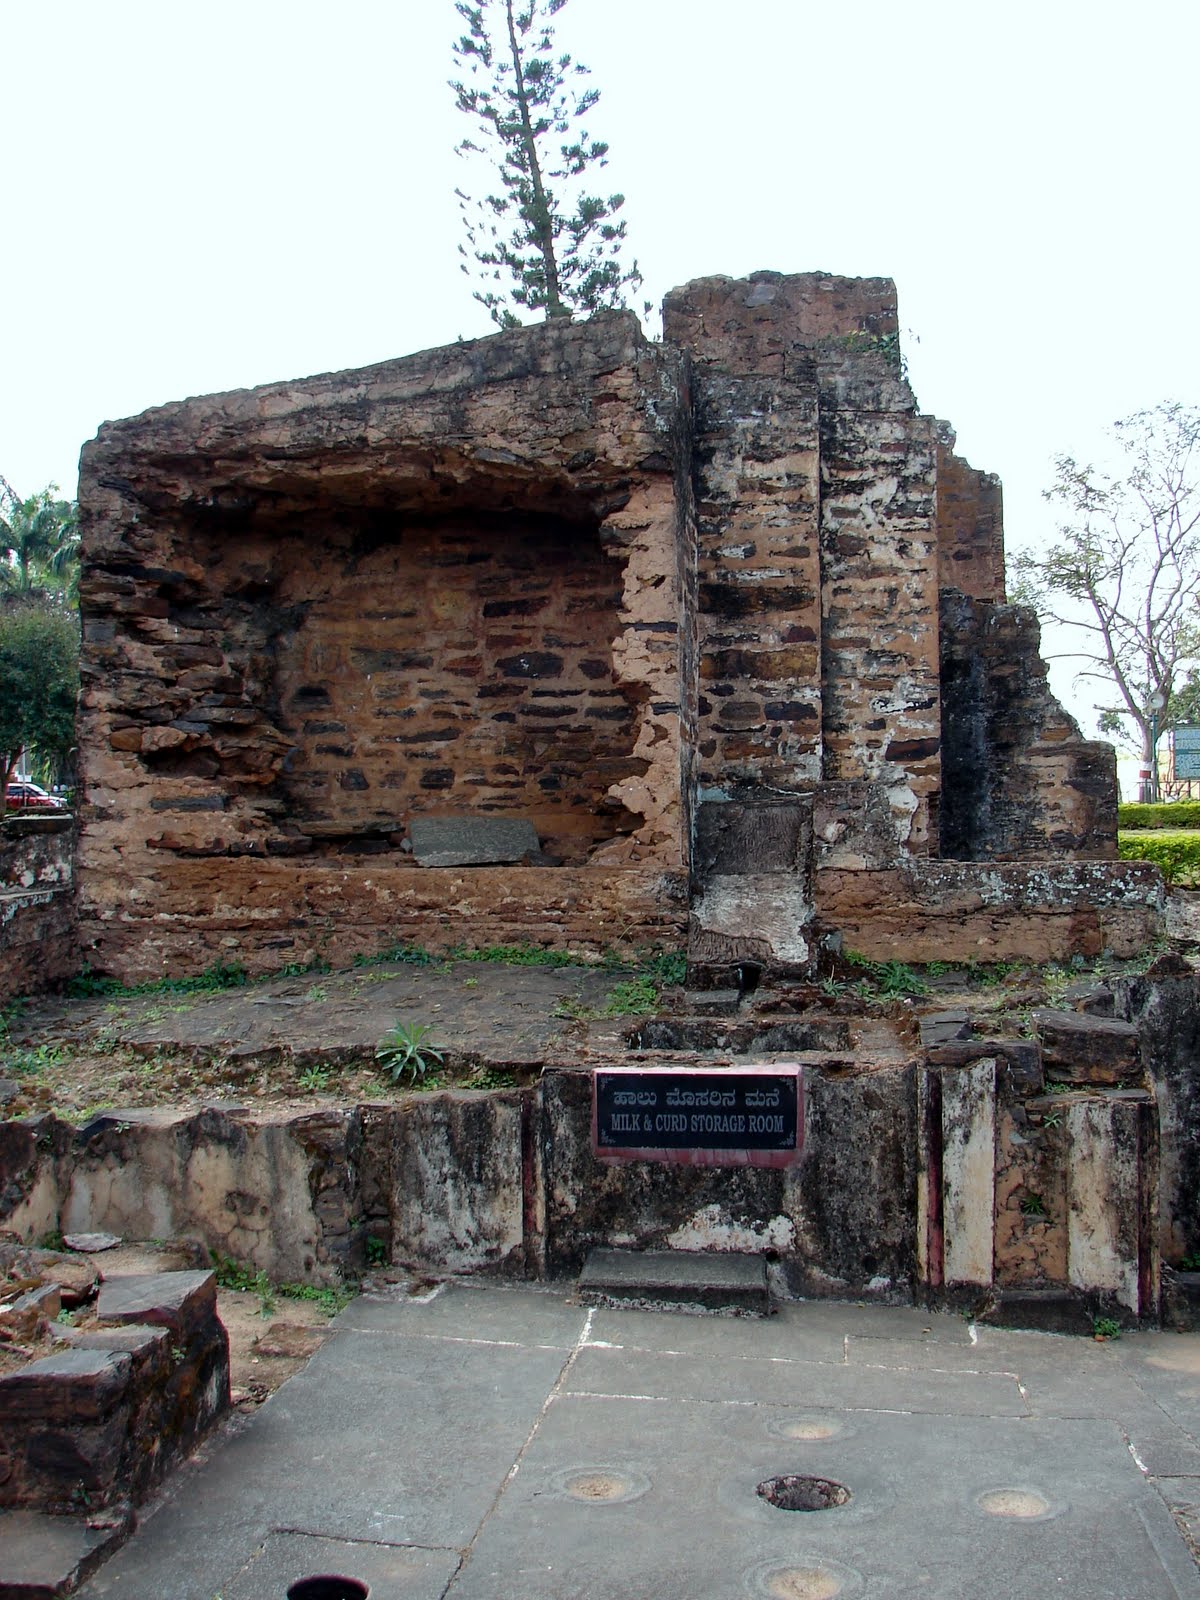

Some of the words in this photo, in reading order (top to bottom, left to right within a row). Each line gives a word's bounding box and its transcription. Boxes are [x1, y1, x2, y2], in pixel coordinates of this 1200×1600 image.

[613, 1090, 657, 1106] ಹಾಲು
[745, 1088, 780, 1107] ಮನೆ
[611, 1113, 641, 1131] MILK
[643, 1115, 653, 1132] &
[655, 1114, 688, 1132] CURD
[690, 1114, 745, 1132] STORAGE
[748, 1115, 785, 1133] ROOM
